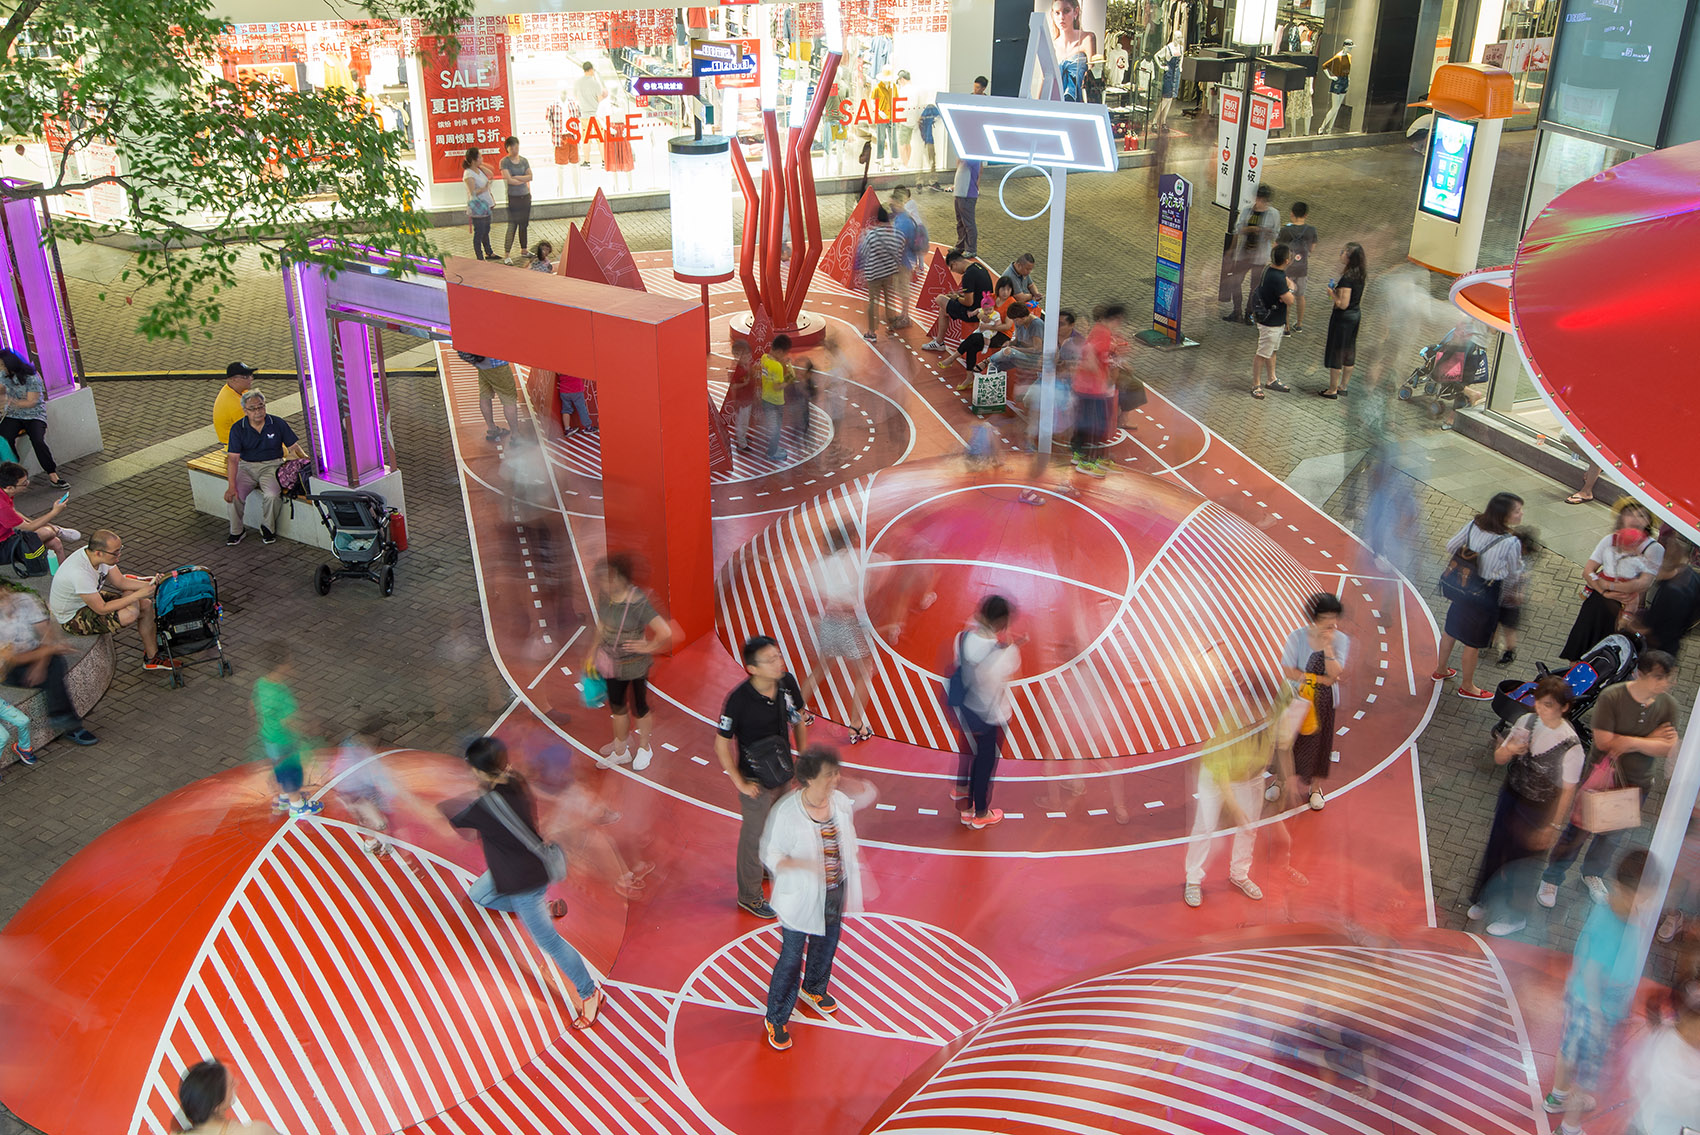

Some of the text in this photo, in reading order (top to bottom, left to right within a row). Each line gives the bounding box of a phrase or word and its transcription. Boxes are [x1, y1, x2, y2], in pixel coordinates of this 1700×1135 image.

[605, 10, 628, 20] SALE
[495, 16, 520, 25] SALE
[290, 23, 317, 32] SALE
[569, 32, 592, 41] SALE
[226, 46, 254, 55] SALE
[320, 42, 346, 51] SALE
[440, 68, 490, 89] SALE
[431, 96, 504, 114] 夏日折扣季
[839, 97, 908, 126] SALE
[566, 113, 643, 145] SALE
